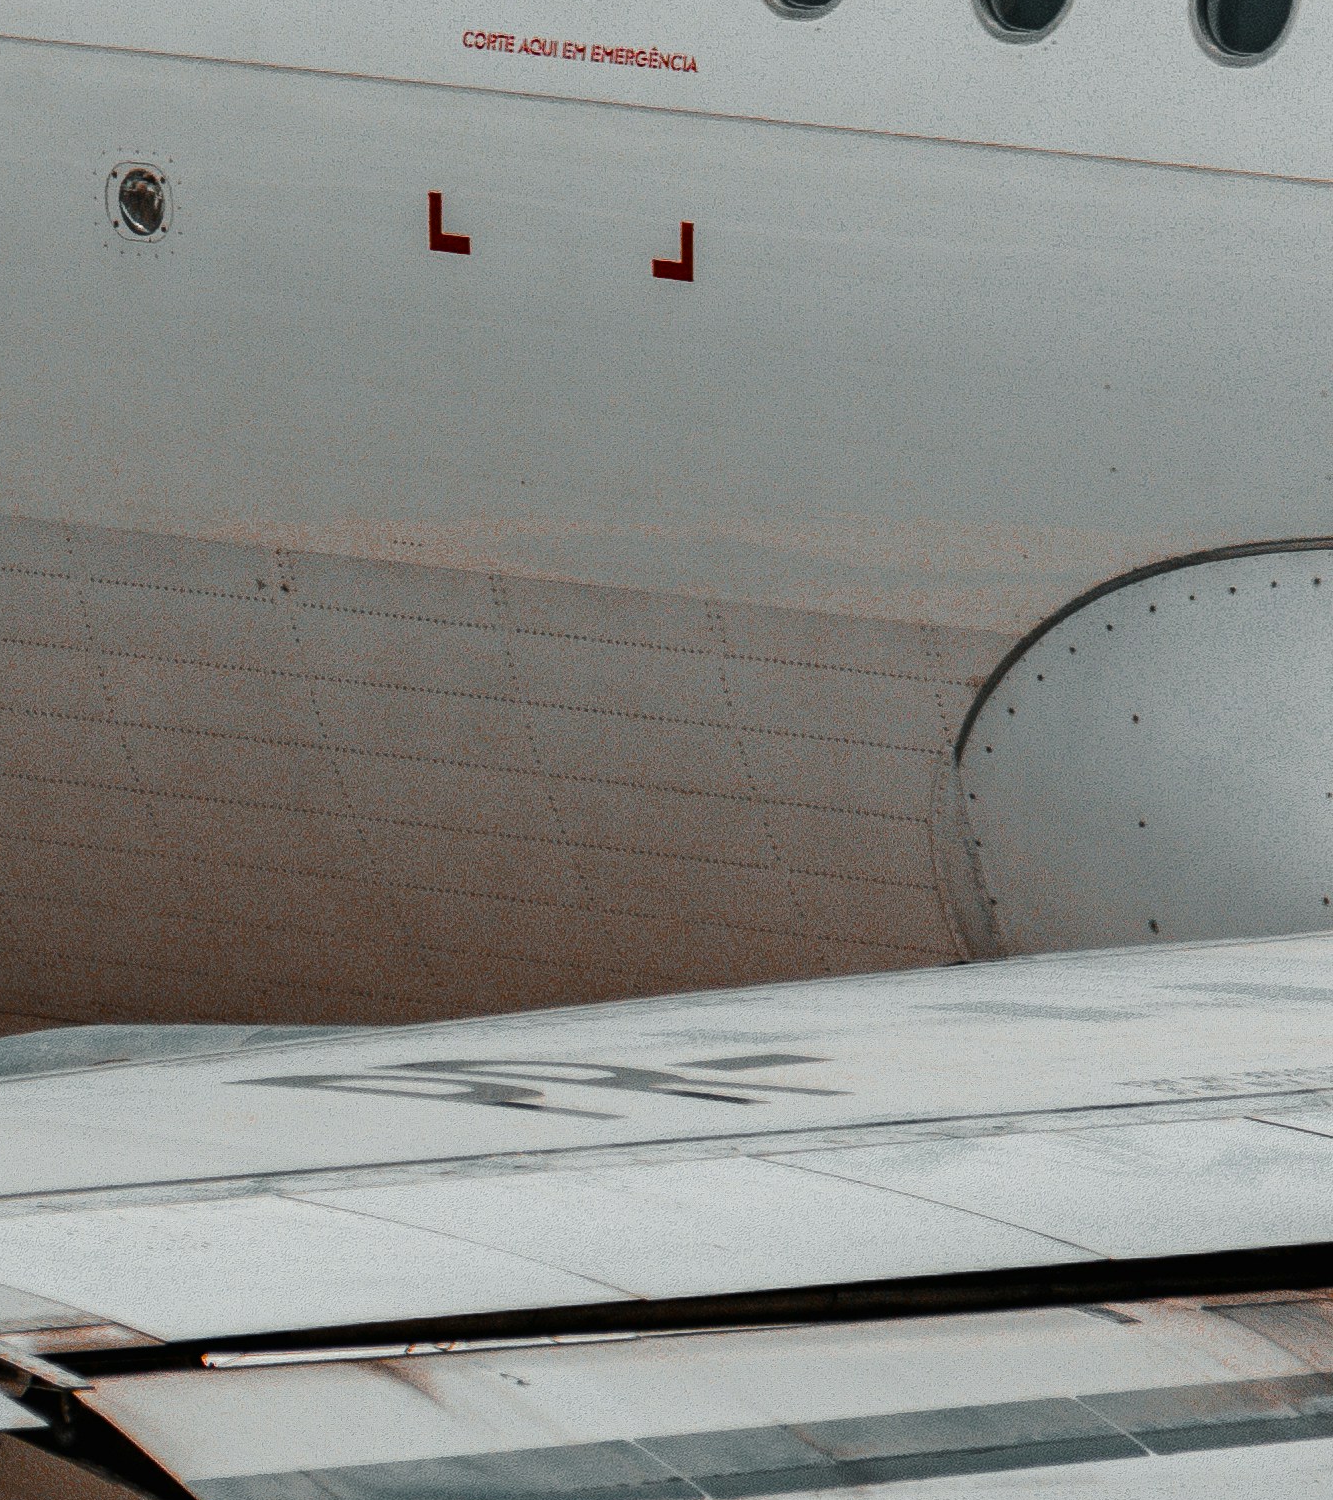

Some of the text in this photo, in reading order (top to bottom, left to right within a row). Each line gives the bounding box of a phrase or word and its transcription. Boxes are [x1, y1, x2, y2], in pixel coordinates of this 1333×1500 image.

[462, 30, 700, 73] CORTE AQUI EM EMERGÊNCIA
